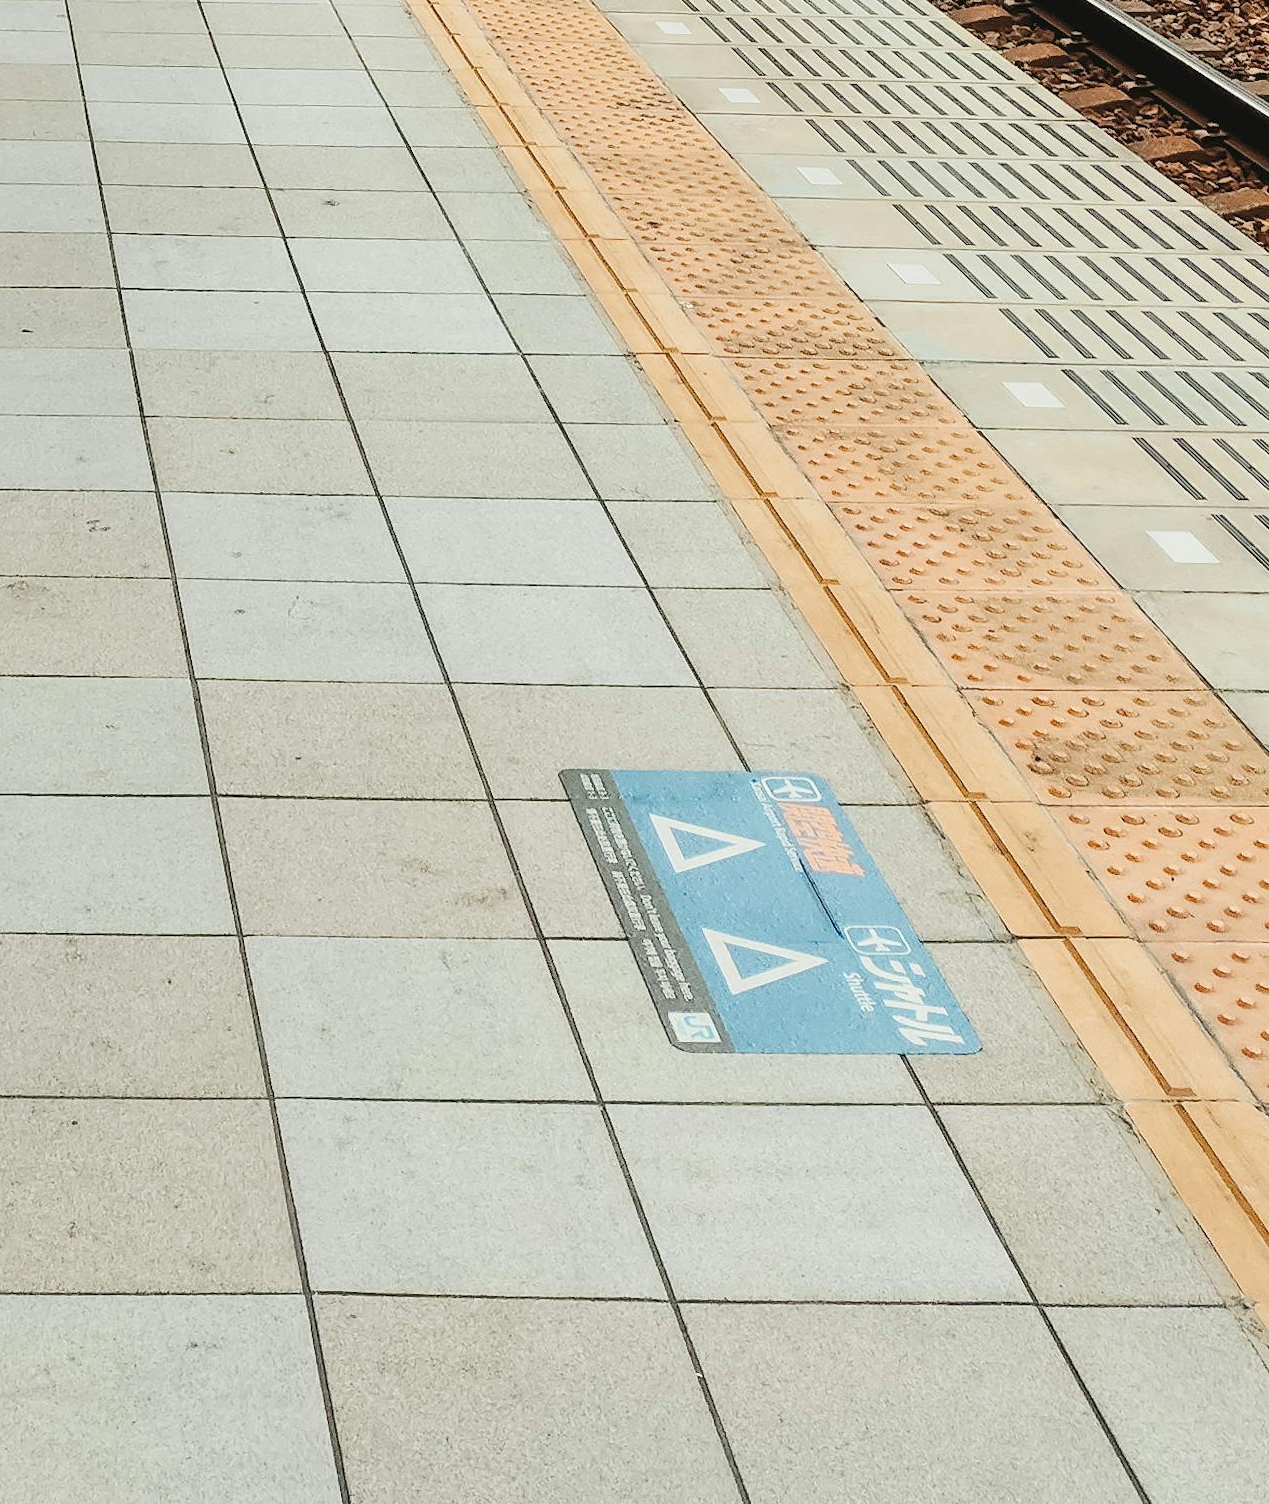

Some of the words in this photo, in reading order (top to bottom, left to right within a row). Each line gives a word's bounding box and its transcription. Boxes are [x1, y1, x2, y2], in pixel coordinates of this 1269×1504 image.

[843, 971, 877, 1013] Shuttle
[864, 956, 966, 1048] シャトル
